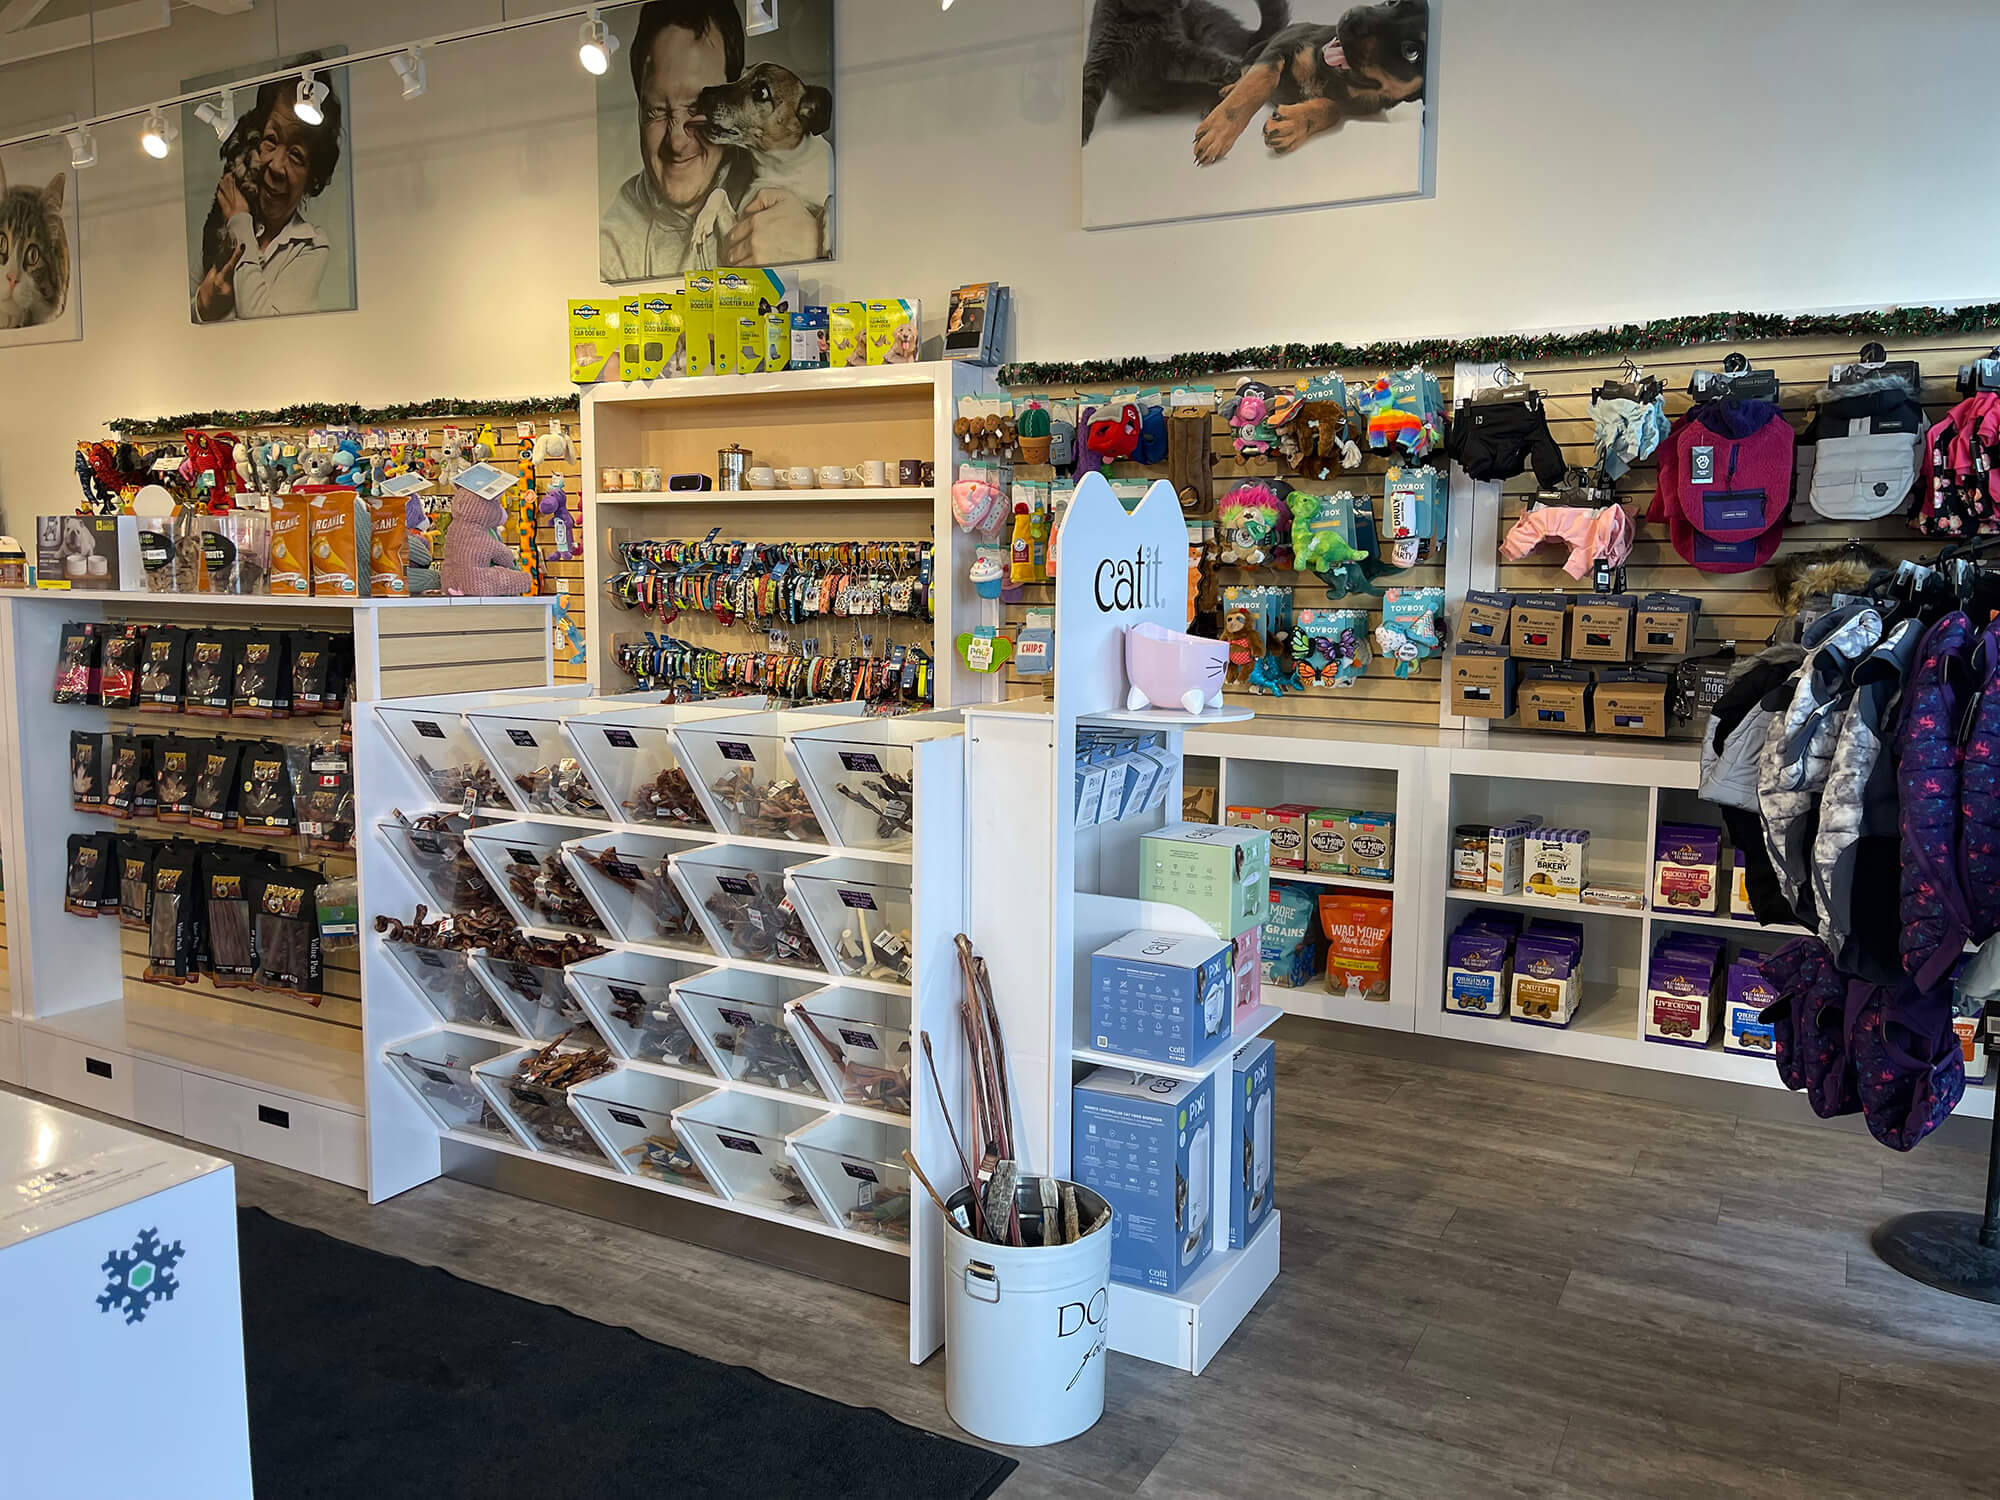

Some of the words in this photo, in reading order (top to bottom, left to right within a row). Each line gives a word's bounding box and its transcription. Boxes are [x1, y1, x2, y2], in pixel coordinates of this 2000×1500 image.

[1305, 626, 1338, 634] TOYBOX
[1022, 643, 1043, 653] CHIPS
[1705, 683, 1724, 693] DOG
[1284, 833, 1300, 843] MORE
[1312, 836, 1326, 845] WAG
[1327, 838, 1344, 848] MORE
[1352, 840, 1367, 849] WAG
[1368, 842, 1385, 852] MORE
[1537, 861, 1568, 870] BAKERY
[1270, 904, 1296, 920] MORE
[1265, 924, 1305, 938] GRAINS
[1331, 924, 1355, 937] WAG
[1356, 925, 1386, 941] MORE
[310, 938, 319, 959] Value
[310, 960, 319, 978] Pack
[1456, 976, 1490, 984] ORIGINAL
[1520, 983, 1557, 994] P-NUTTIER
